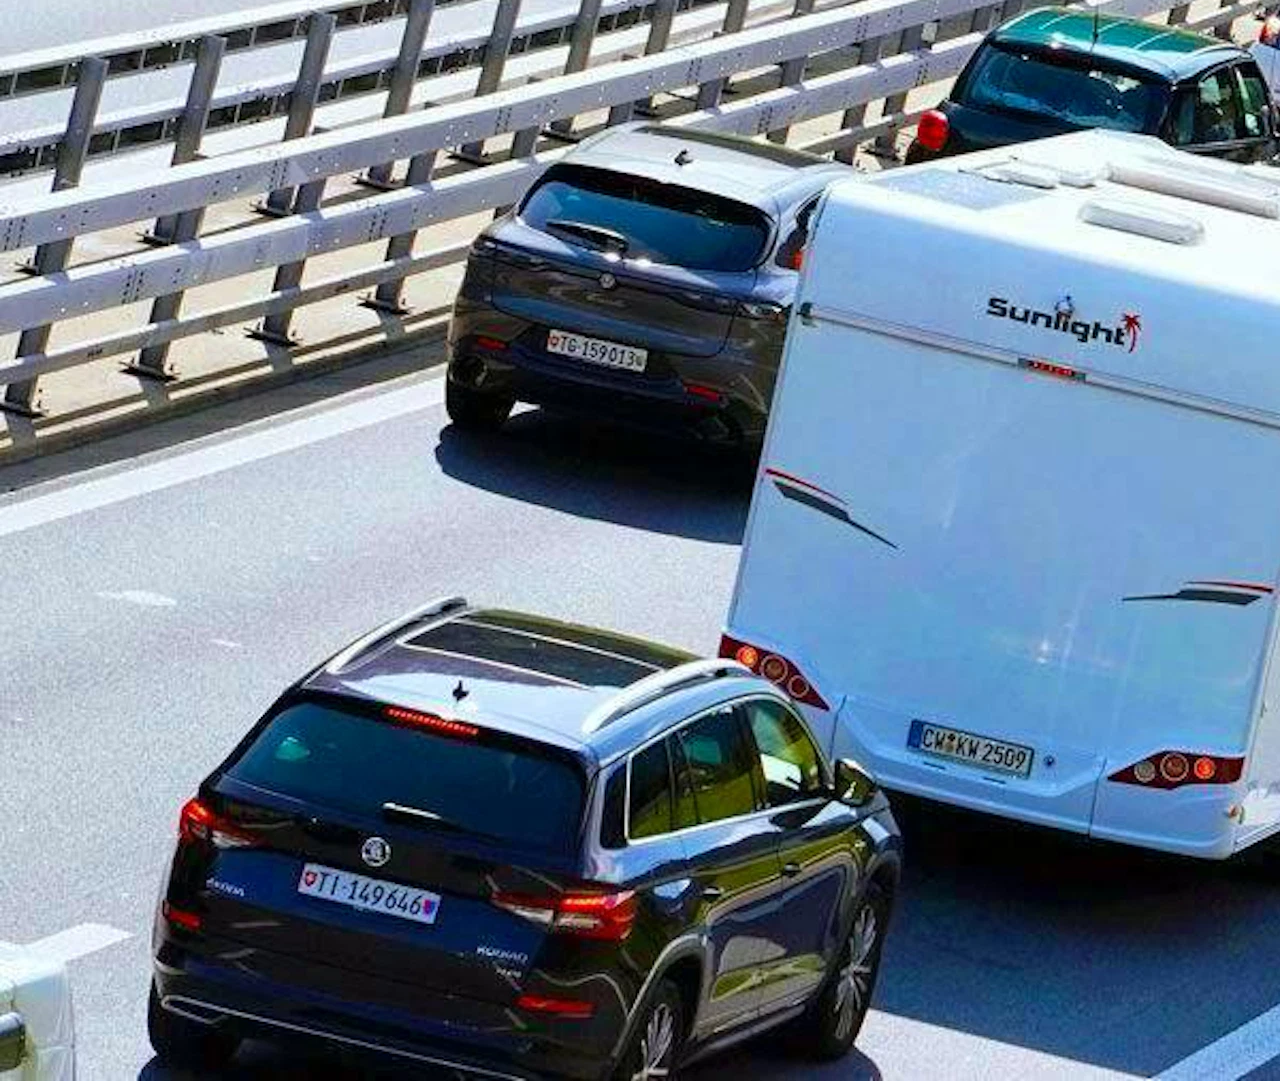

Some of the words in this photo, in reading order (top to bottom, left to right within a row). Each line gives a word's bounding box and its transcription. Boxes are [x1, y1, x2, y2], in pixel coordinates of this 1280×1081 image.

[986, 297, 1126, 346] Sunlight
[923, 728, 946, 752] CW
[955, 735, 981, 760] KW
[981, 743, 1027, 771] 2509
